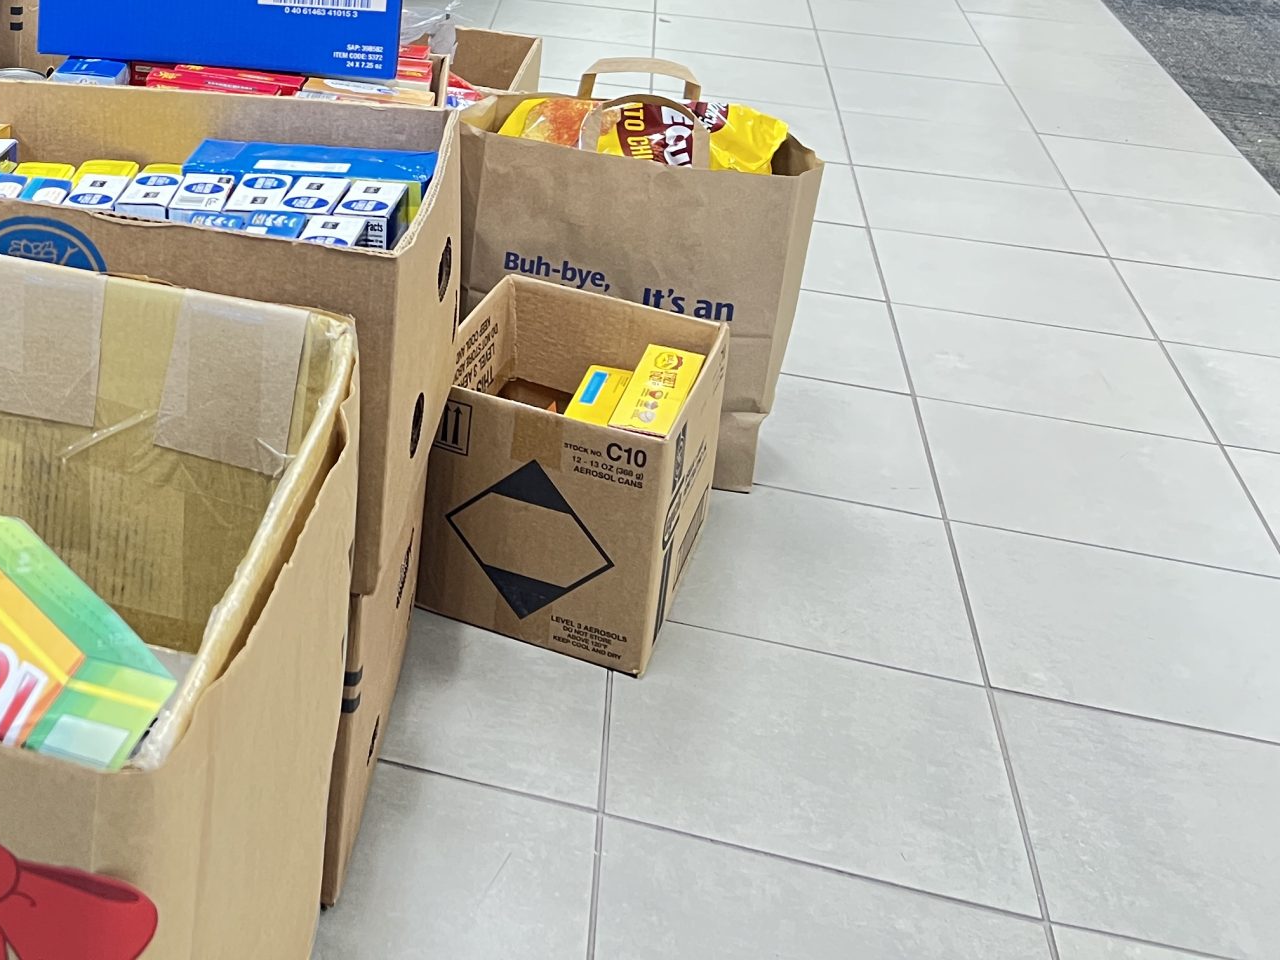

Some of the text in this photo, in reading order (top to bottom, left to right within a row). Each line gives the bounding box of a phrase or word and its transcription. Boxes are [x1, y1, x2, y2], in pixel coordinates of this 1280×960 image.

[291, 7, 301, 15] 40
[302, 8, 326, 16] 61463
[328, 10, 351, 18] 41015
[352, 10, 358, 18] 3
[626, 136, 654, 161] CHI
[366, 221, 383, 232] Facts
[503, 251, 610, 293] Buh-bye,
[694, 299, 735, 322] an
[564, 442, 647, 468] STOCK NO. C10
[572, 455, 582, 463] 12
[590, 459, 599, 468] 13
[601, 462, 614, 472] OZ
[573, 465, 643, 489] AEROSOL CANS
[550, 615, 575, 628] LEVEL
[584, 624, 627, 643] AEROSOLS
[563, 625, 612, 645] DO NOT STORE
[567, 633, 590, 645] ABOVE
[552, 635, 622, 660] KEEP COOL AND DRY
